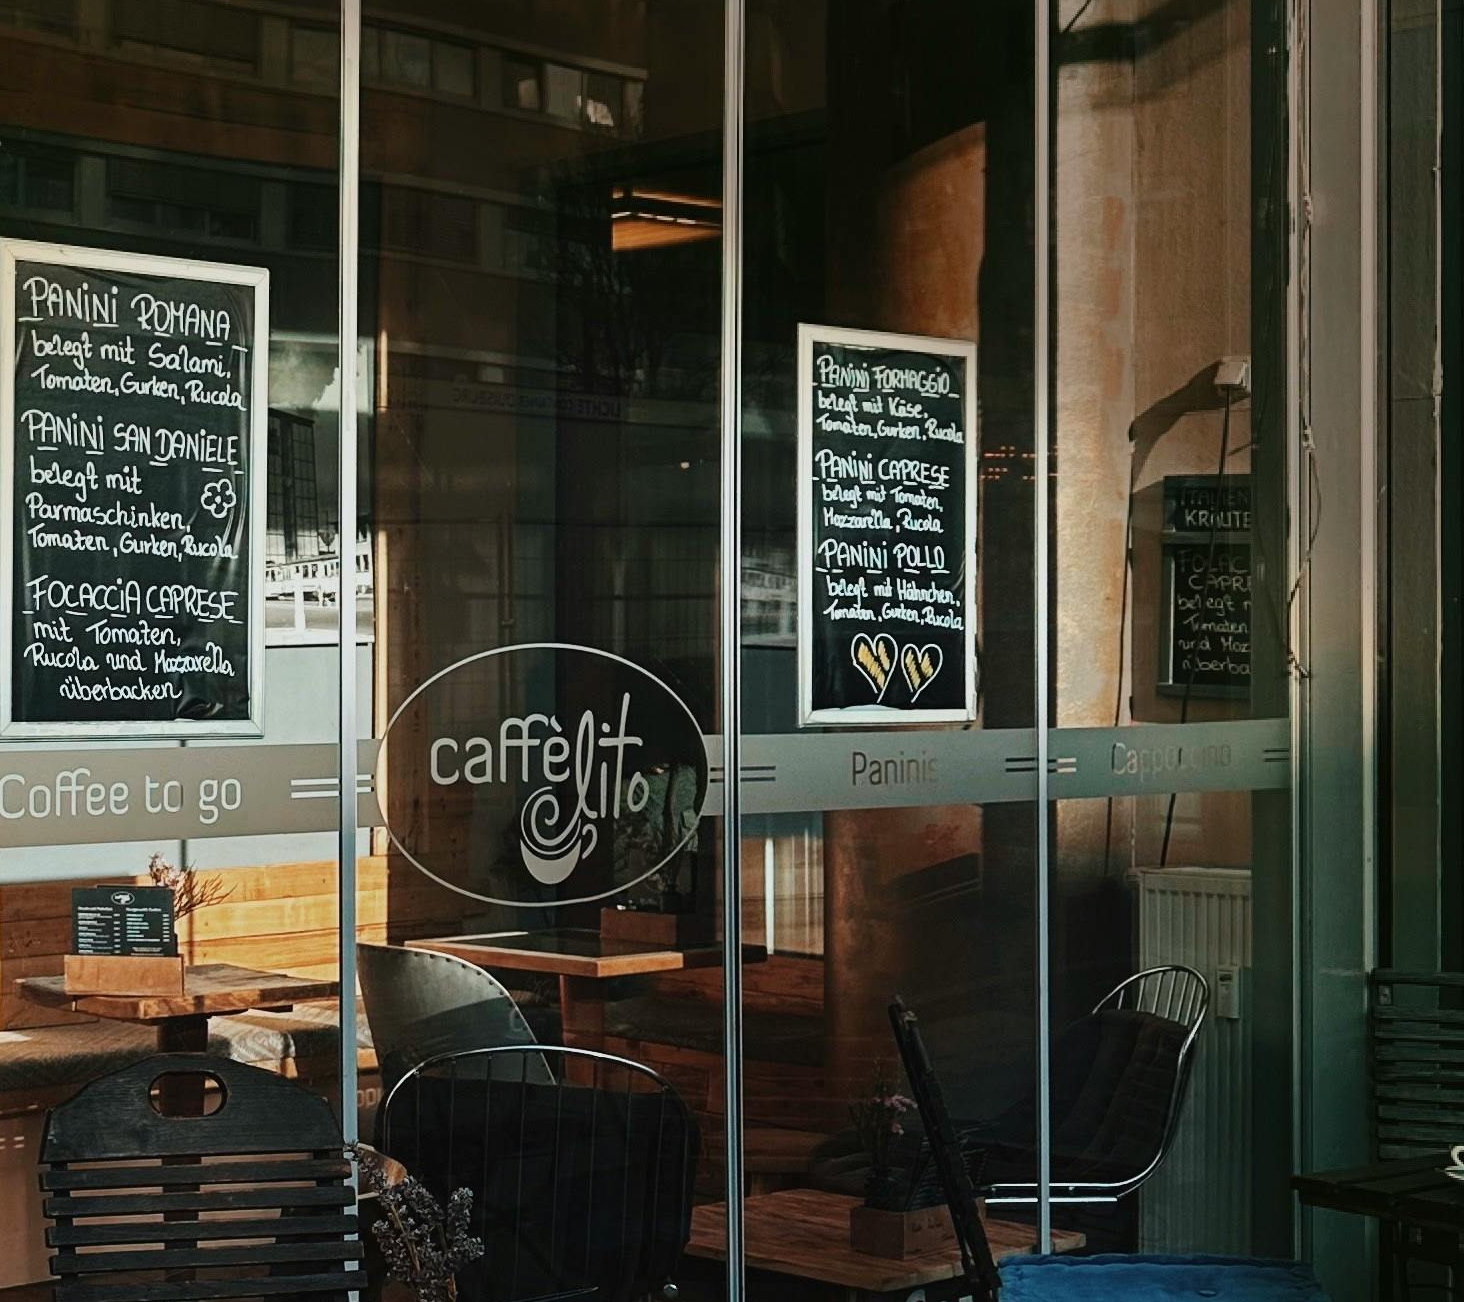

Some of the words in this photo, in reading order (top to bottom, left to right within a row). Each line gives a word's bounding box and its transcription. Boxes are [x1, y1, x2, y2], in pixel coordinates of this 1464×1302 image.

[131, 294, 230, 340] ROMANA
[31, 329, 92, 370] belegt
[101, 335, 135, 365] mit
[31, 364, 119, 396] Tomaten,
[120, 372, 185, 405] Gurken,
[185, 379, 247, 411] Rucola
[818, 390, 858, 419] belegt
[862, 396, 883, 413] mit
[114, 423, 151, 454] SAN
[925, 418, 964, 443] Rucola
[30, 455, 98, 502] belegt
[106, 465, 142, 495] mit
[878, 459, 950, 486] CAPRESE
[822, 483, 862, 508] belegt
[866, 485, 886, 502] mit
[897, 508, 944, 533] Rucola
[28, 523, 118, 557] Tomaten,
[119, 532, 182, 562] Gurken,
[181, 534, 238, 558] Rucola
[893, 543, 945, 569] POLLO
[146, 584, 239, 620] CAPRESE
[826, 575, 868, 607] belegt
[874, 577, 893, 597] mit
[34, 617, 73, 643] mit
[85, 619, 181, 646] Tomaten,
[922, 606, 964, 630] Rucola
[24, 642, 99, 671] Rucola
[106, 649, 147, 671] und
[155, 642, 235, 676] Mozzarella
[59, 676, 183, 701] überbacken
[144, 774, 183, 814] to
[198, 776, 242, 825] go
